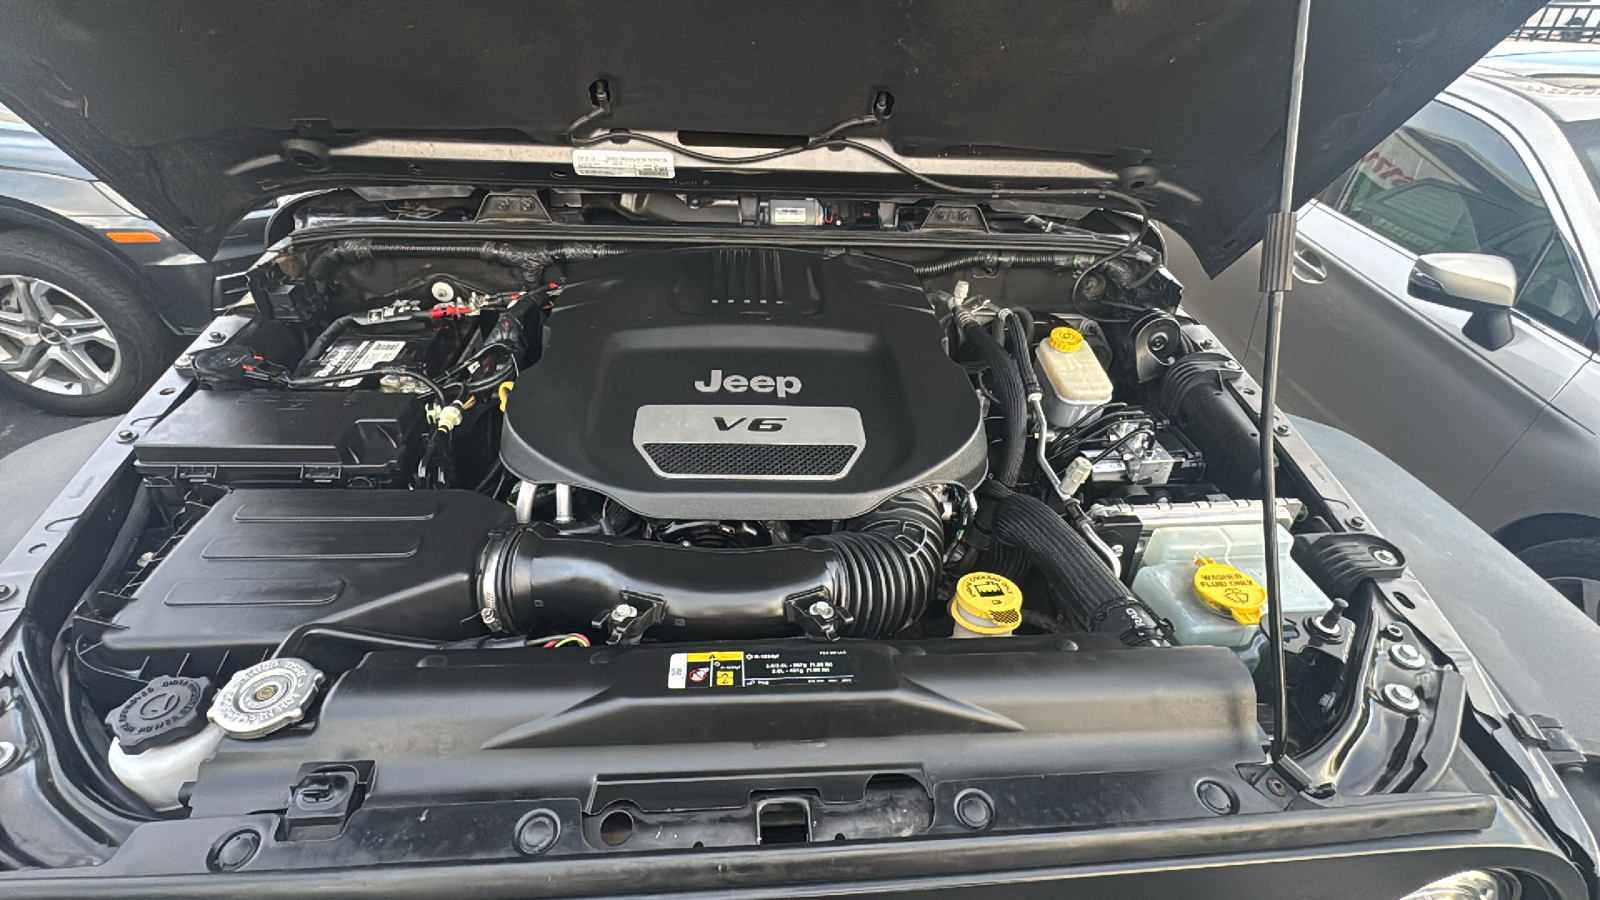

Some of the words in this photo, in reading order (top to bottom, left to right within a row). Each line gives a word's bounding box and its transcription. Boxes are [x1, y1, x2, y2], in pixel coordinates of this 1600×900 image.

[694, 369, 802, 399] Jeep
[713, 416, 788, 432] V6
[1200, 573, 1243, 581] WASHER
[1199, 580, 1228, 588] FLUID
[1228, 579, 1254, 587] ONLY
